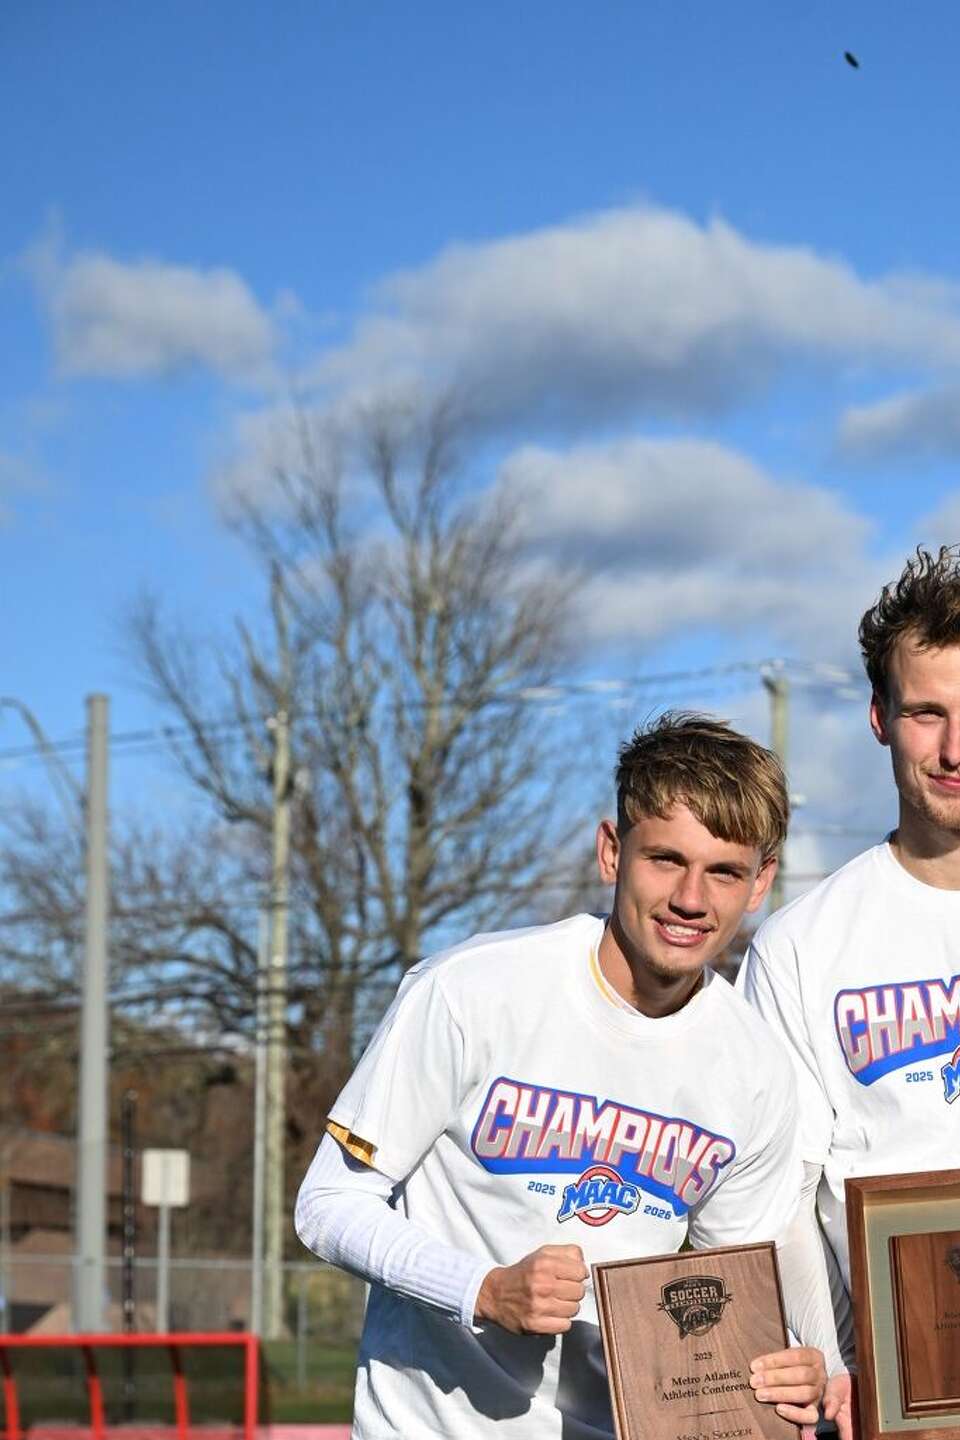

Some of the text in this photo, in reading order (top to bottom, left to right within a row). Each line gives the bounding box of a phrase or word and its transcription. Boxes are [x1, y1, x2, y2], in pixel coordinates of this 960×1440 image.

[905, 1070, 934, 1083] 2025
[527, 1180, 672, 1221] 2025 2026
[557, 1177, 641, 1223] MAAC
[669, 1286, 719, 1303] SOCCER
[693, 1351, 713, 1361] 2025
[671, 1369, 742, 1387] Metro Atlantic
[661, 1387, 699, 1402] Athletic
